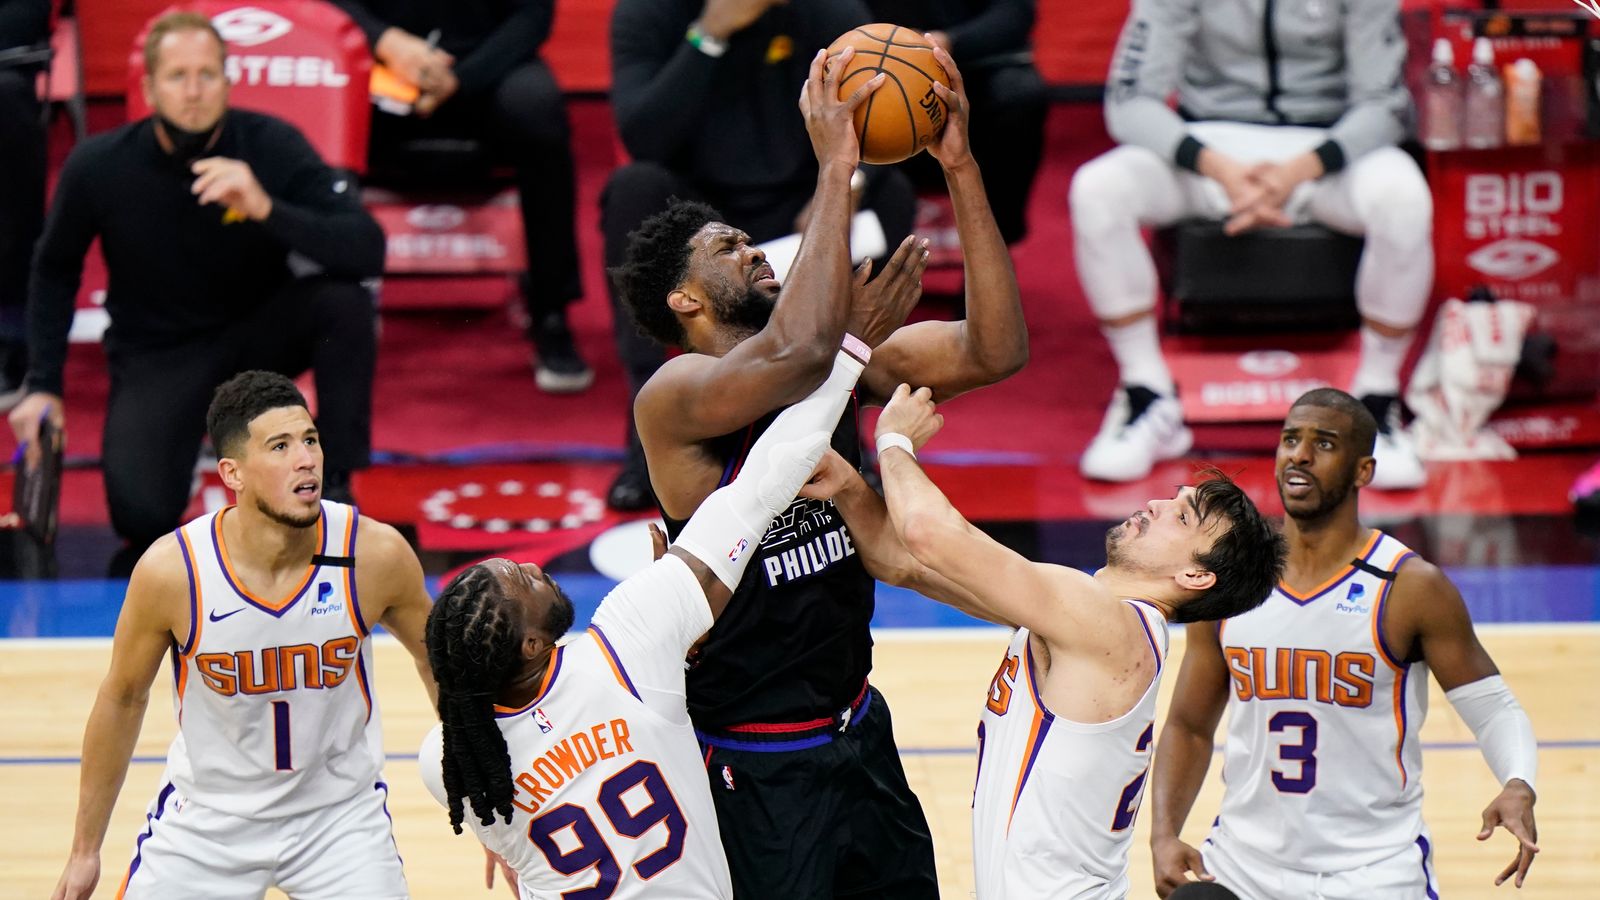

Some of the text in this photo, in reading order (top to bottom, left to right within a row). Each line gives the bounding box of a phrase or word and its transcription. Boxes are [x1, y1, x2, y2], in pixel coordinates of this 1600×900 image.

[224, 55, 350, 87] STEEL
[1465, 171, 1563, 214] BIO
[311, 602, 342, 615] PayPal
[196, 636, 358, 696] SUNS
[1225, 646, 1376, 709] SUNS
[270, 699, 296, 772] 1
[511, 718, 634, 814] CROWDER
[1268, 711, 1318, 795] 3
[528, 759, 688, 900] 99
